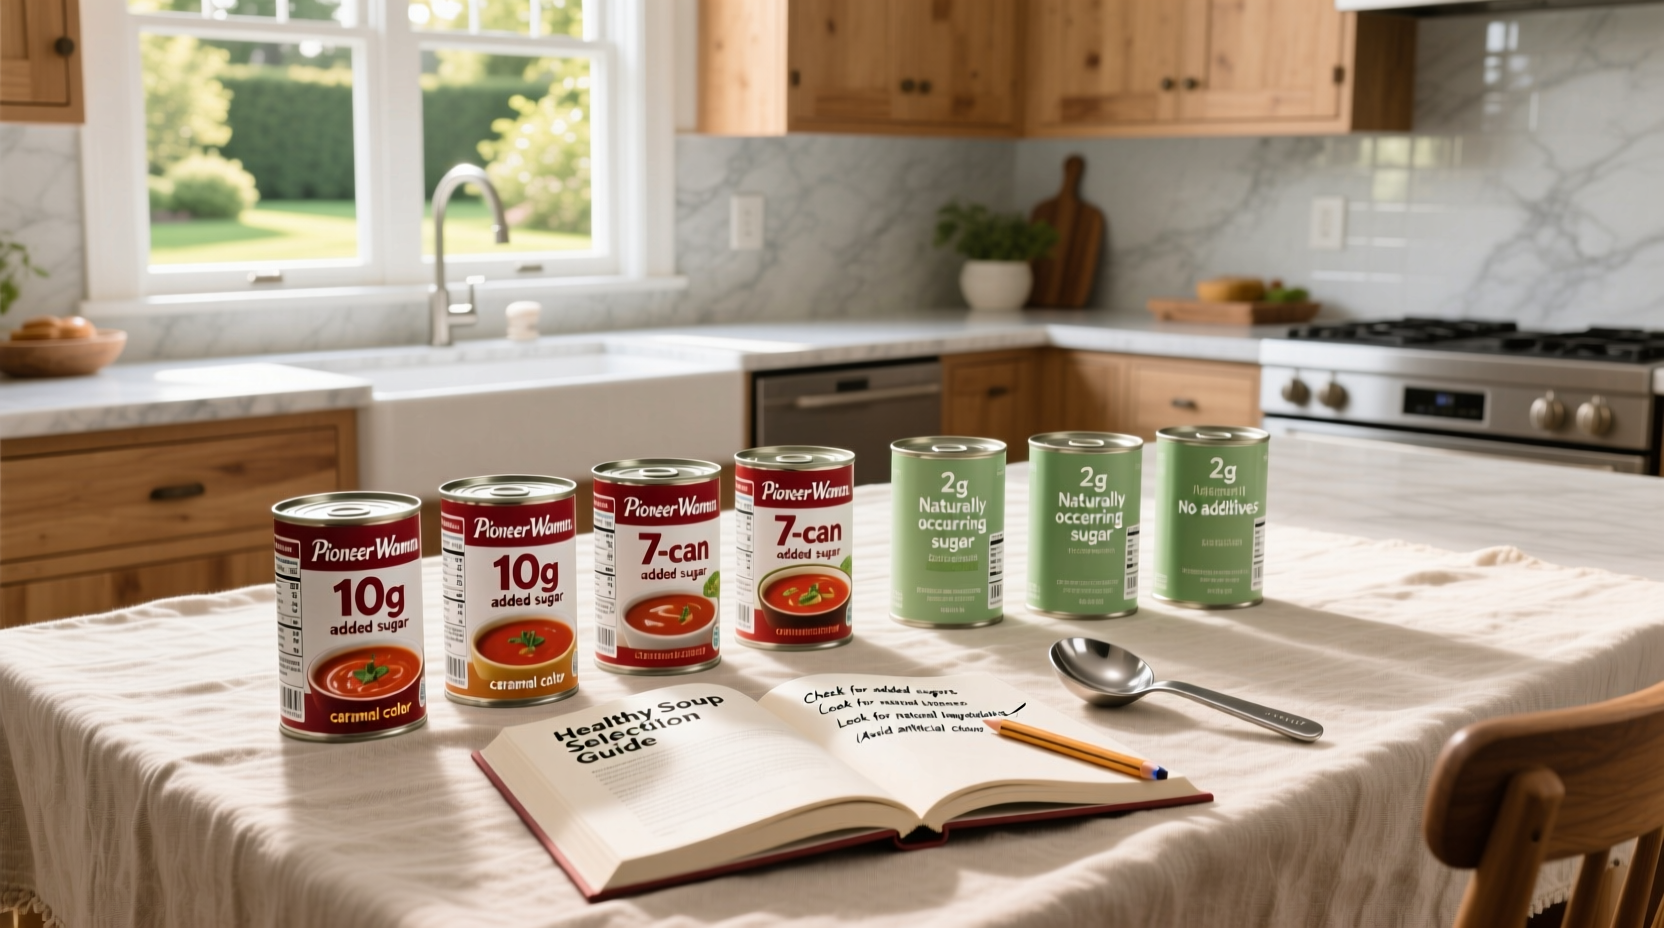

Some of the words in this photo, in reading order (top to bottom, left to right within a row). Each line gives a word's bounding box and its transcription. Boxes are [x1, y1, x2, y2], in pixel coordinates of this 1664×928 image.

[1080, 466, 1107, 492] 2g
[1209, 457, 1237, 484] 2g
[940, 471, 968, 498] 2g
[919, 496, 987, 515] Naturally
[1058, 491, 1125, 508] Naturally
[1178, 500, 1197, 515] No
[473, 517, 530, 539] Pioneer
[774, 515, 842, 546] 7-can
[918, 516, 987, 534] occurring
[931, 536, 975, 552] sugar
[1071, 529, 1114, 546] sugar
[311, 539, 375, 562] Pioneer
[638, 532, 709, 565] 7-can
[776, 548, 812, 560] added
[493, 553, 559, 592] 10g
[641, 567, 677, 581] added
[333, 576, 406, 618] 10g
[491, 593, 531, 608] added
[535, 592, 564, 607] sugar
[330, 620, 374, 636] added
[377, 617, 410, 634] sugar
[553, 708, 652, 742] Healthy
[657, 695, 725, 713] Soup
[836, 713, 871, 728] Look
[873, 712, 890, 721] for
[576, 737, 658, 764] Guide
